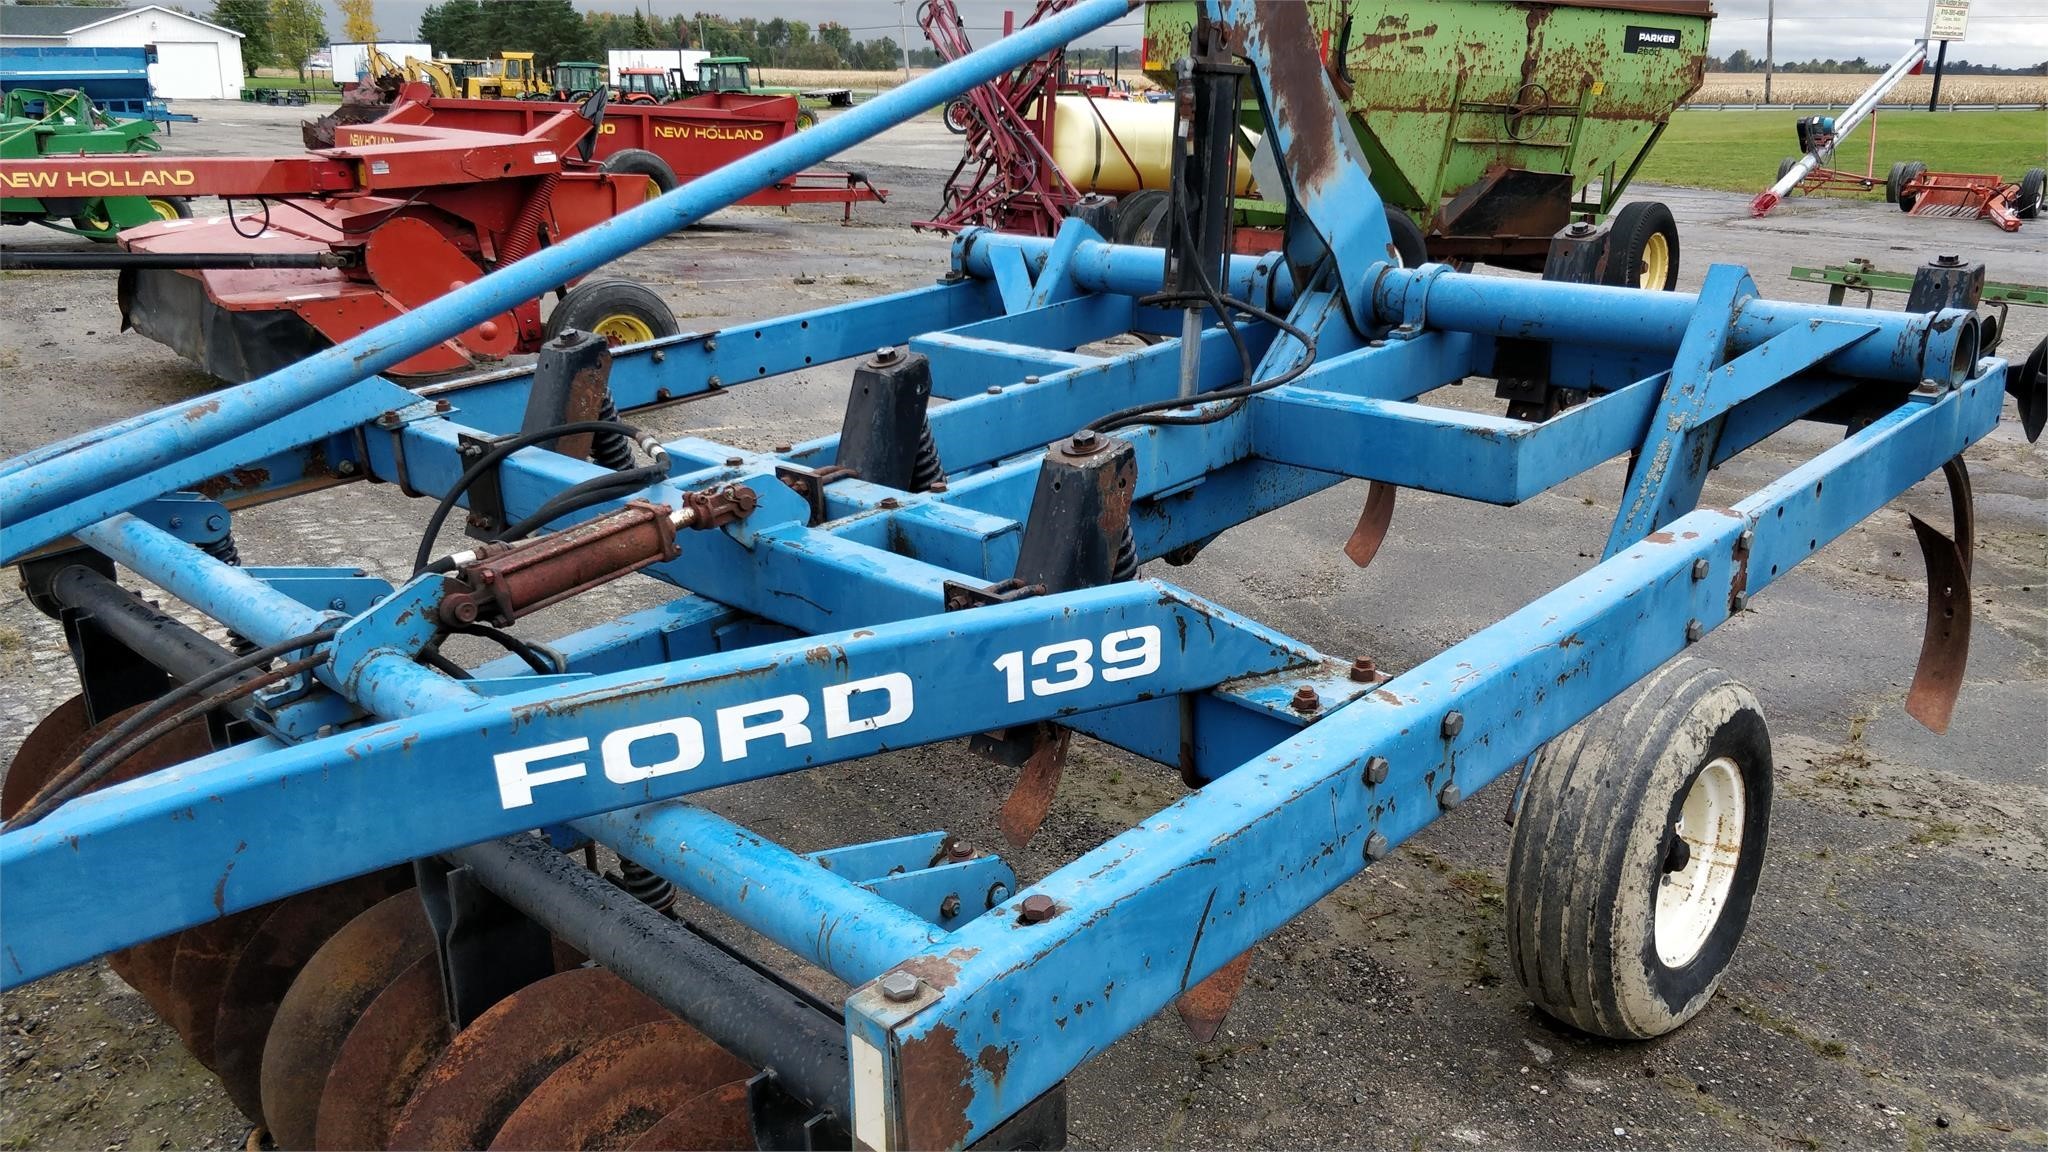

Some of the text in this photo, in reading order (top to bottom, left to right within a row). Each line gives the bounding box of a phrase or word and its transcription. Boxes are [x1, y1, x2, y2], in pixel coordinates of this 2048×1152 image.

[1638, 32, 1676, 44] PARKER
[350, 133, 364, 146] NEW
[655, 126, 764, 141] NEW HOLLAND
[0, 170, 195, 188] NEW HOLLAND
[493, 624, 1161, 810] FORD 139
